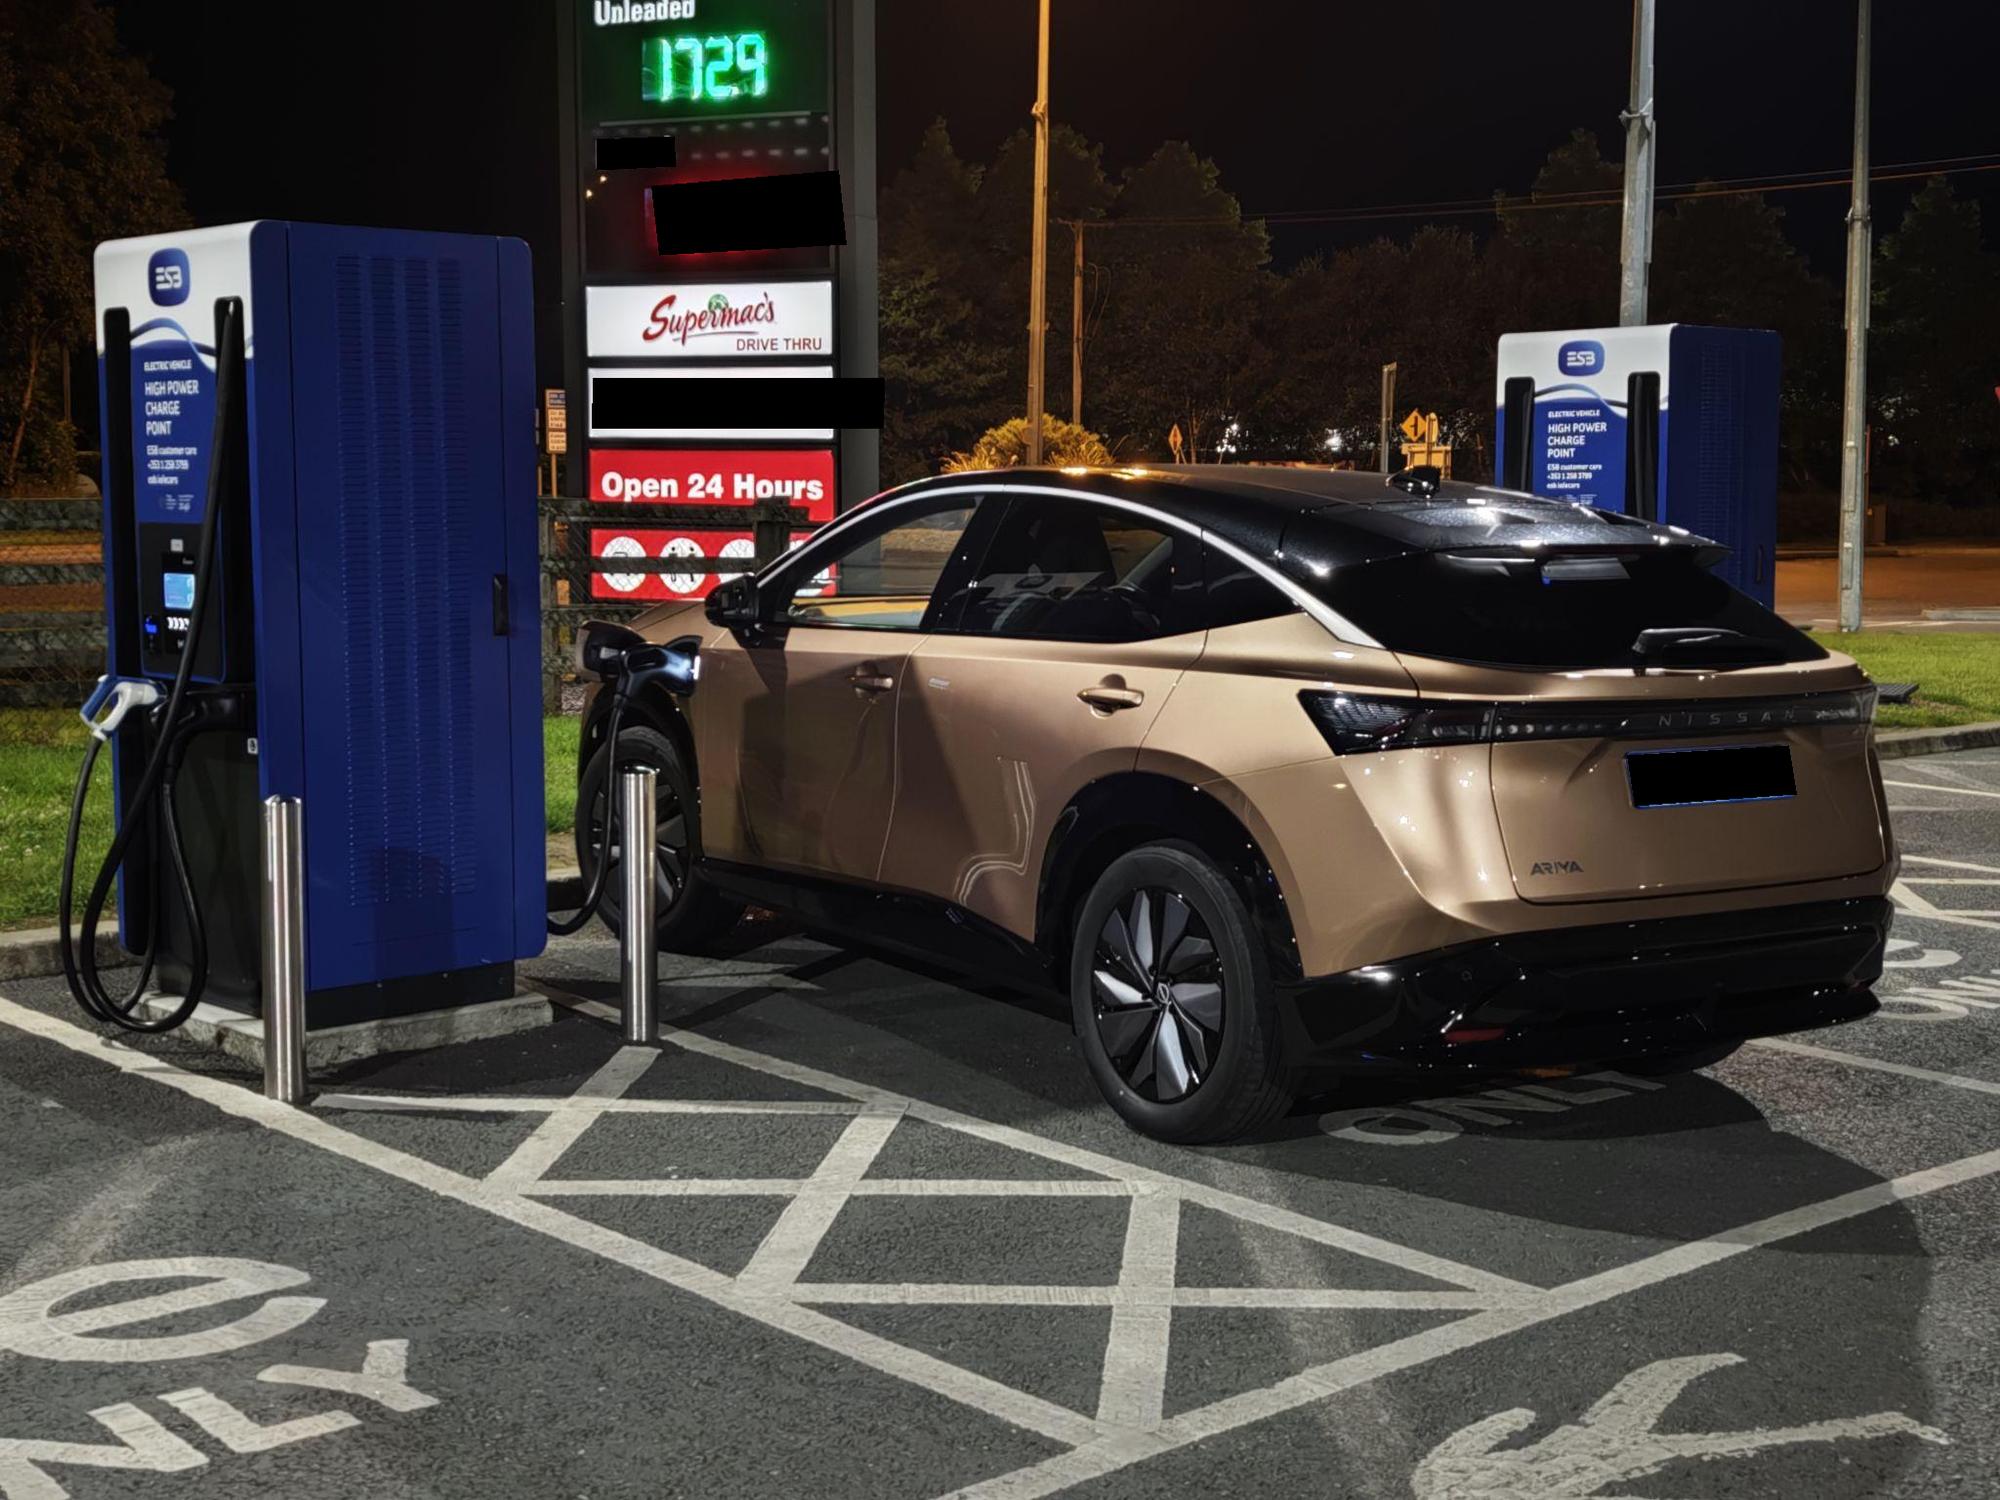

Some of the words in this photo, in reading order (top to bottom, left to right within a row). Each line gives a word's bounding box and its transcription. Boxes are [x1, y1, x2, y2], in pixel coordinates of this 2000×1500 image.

[594, 0, 695, 25] Unleaded
[155, 265, 183, 290] ESB
[642, 291, 775, 346] Supermac's
[736, 338, 778, 351] DRIVE
[783, 337, 822, 351] THRU
[1566, 350, 1596, 367] ESB
[145, 381, 166, 396] HIGH
[167, 379, 199, 395] POWER
[145, 400, 180, 416] CHARGE
[1548, 410, 1575, 418] ELECTRIC
[1576, 409, 1600, 417] VEHICLE
[146, 420, 172, 436] POINT
[1547, 423, 1571, 433] HIGH
[1572, 421, 1607, 432] POWER
[1547, 435, 1585, 446] CHARGE
[1547, 447, 1576, 458] POINT
[601, 471, 679, 502] Open
[687, 473, 724, 498] 24
[733, 472, 824, 500] Hours
[1658, 709, 1796, 728] NISSAN
[1530, 860, 1584, 876] ARIYA
